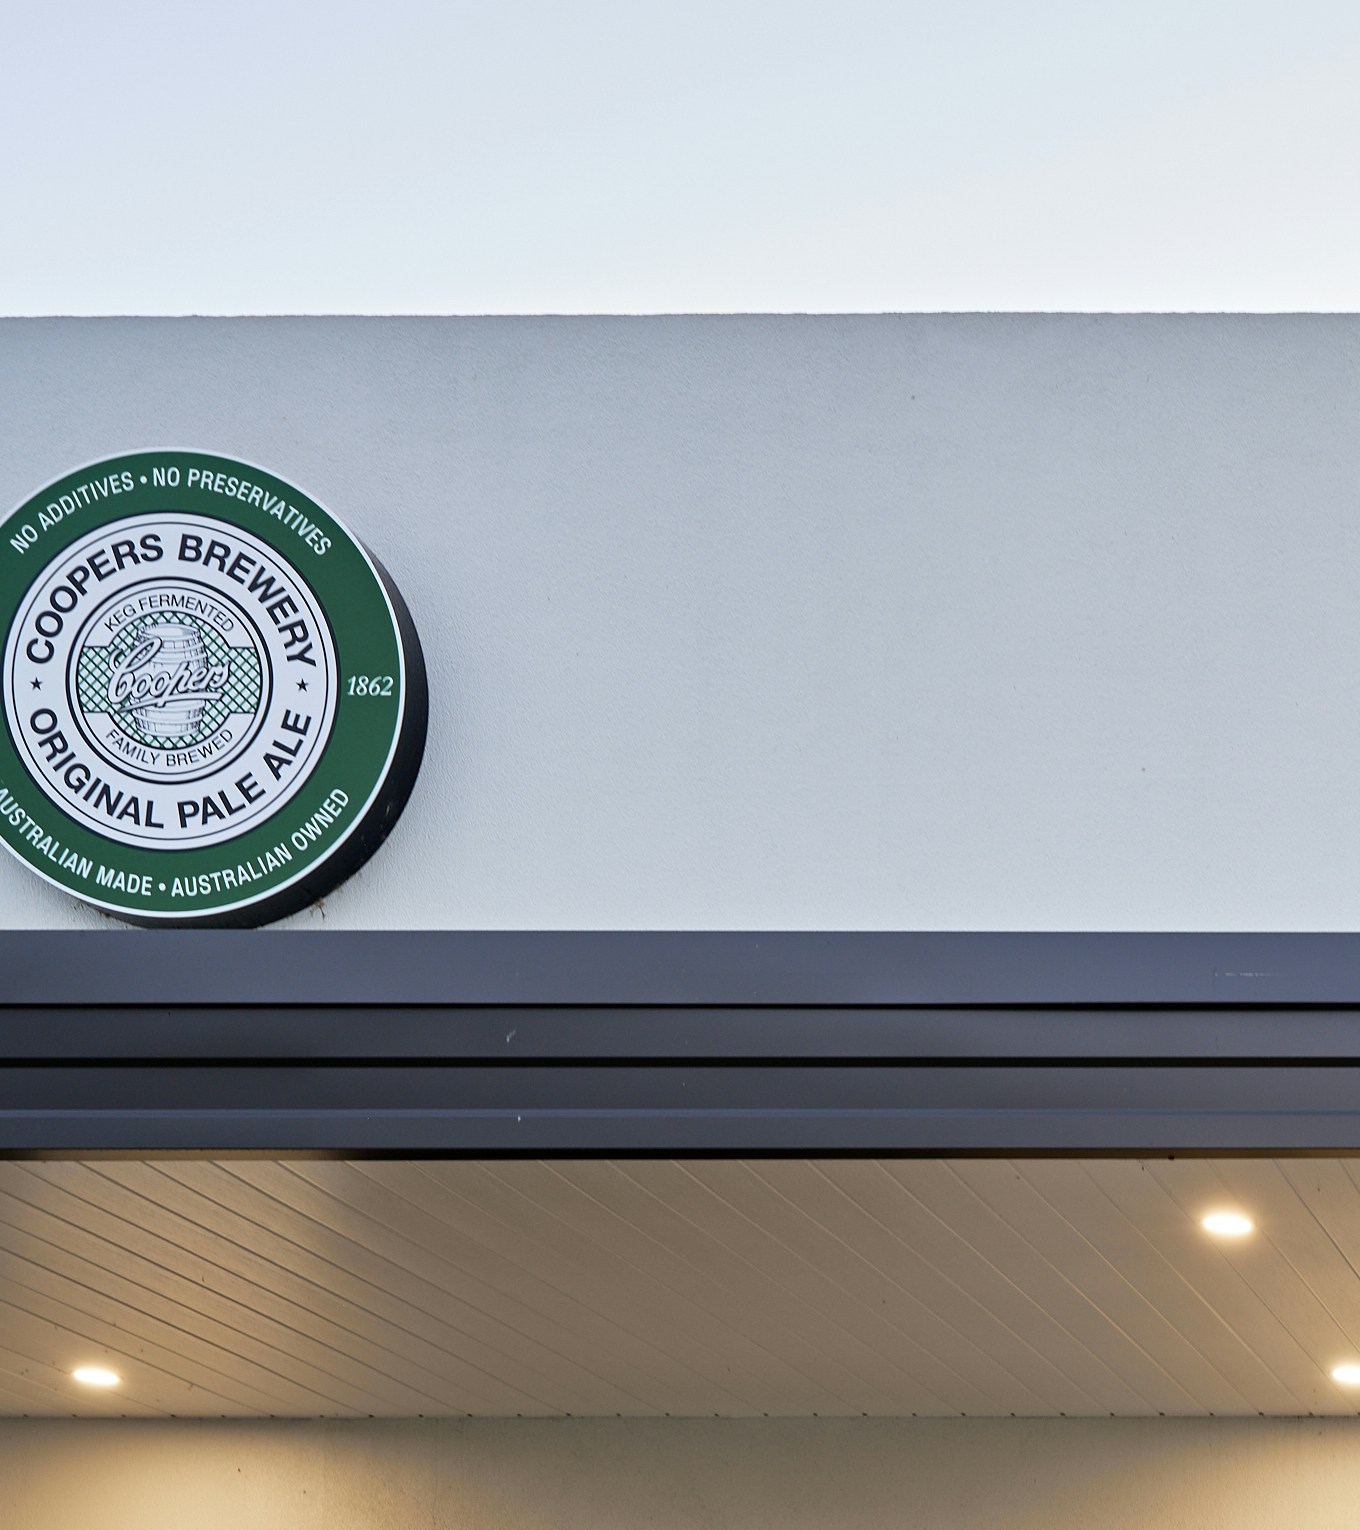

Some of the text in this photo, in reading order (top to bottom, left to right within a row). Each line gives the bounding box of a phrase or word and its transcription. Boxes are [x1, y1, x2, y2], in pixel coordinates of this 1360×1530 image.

[9, 471, 136, 555] NO ADDITIVES
[152, 466, 333, 557] NO PRESERVATIVES
[26, 533, 317, 668] COOPERS BREWERY
[104, 593, 236, 634] KEG FERMENTED
[106, 635, 231, 713] Coopers
[346, 676, 394, 698] 1862
[30, 707, 313, 830] ORIGINAL PALE ALE
[105, 727, 236, 768] FAMILY BREWED
[96, 865, 153, 897] MADE
[170, 787, 350, 898] AUSTRALIAN OWNED
